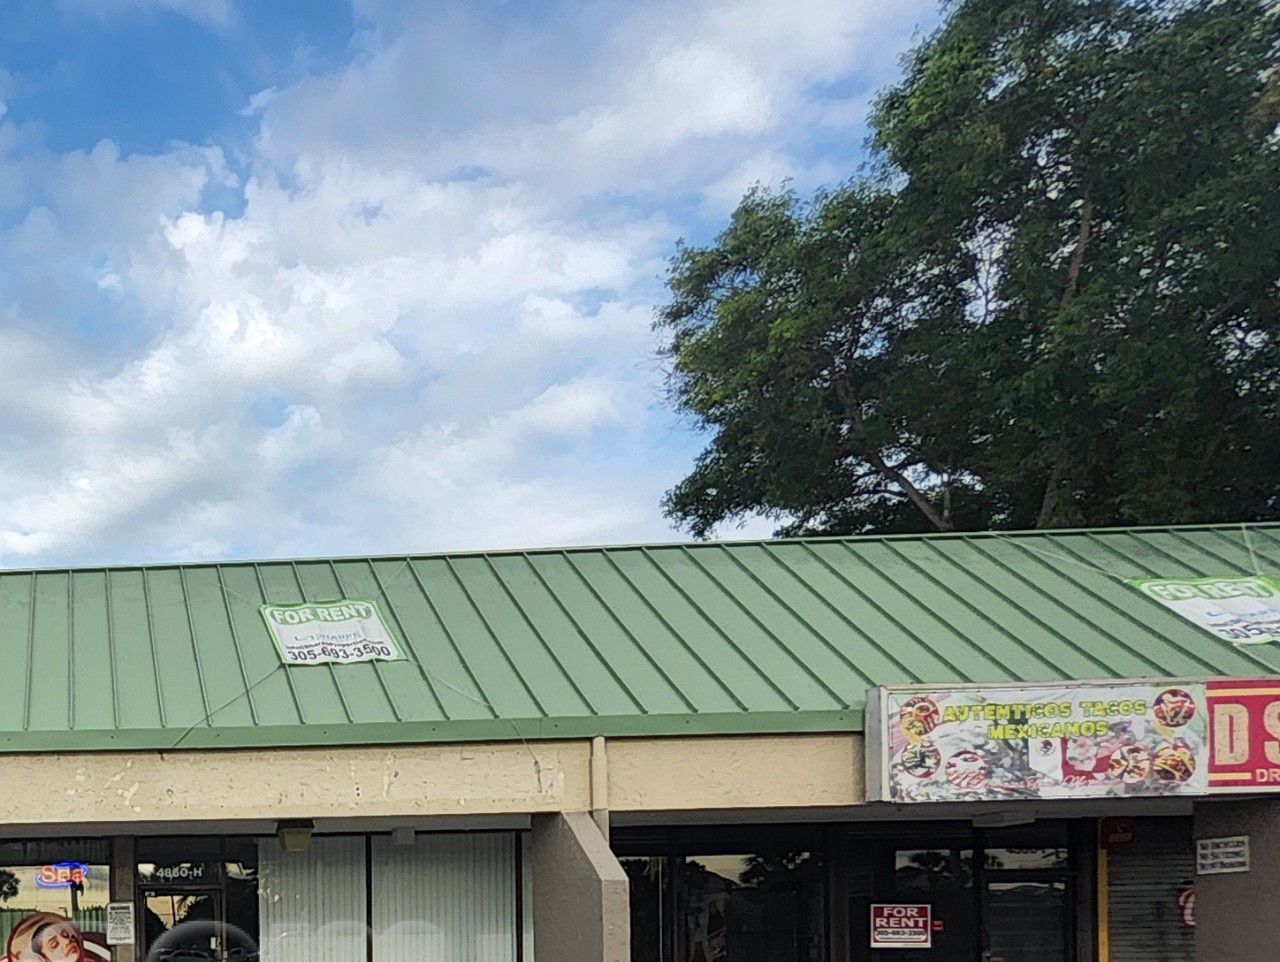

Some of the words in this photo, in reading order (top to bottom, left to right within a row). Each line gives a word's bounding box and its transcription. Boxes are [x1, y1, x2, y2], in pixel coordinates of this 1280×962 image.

[273, 609, 314, 624] FOR
[320, 604, 368, 622] RENT
[287, 644, 391, 661] 305-693-3500
[943, 703, 1072, 722] AUTENTICOS
[1080, 700, 1146, 716] TACOS
[988, 721, 1109, 740] MEXICANOS
[41, 865, 84, 884] Spa
[883, 907, 919, 917] FOR
[875, 917, 927, 928] RENT
